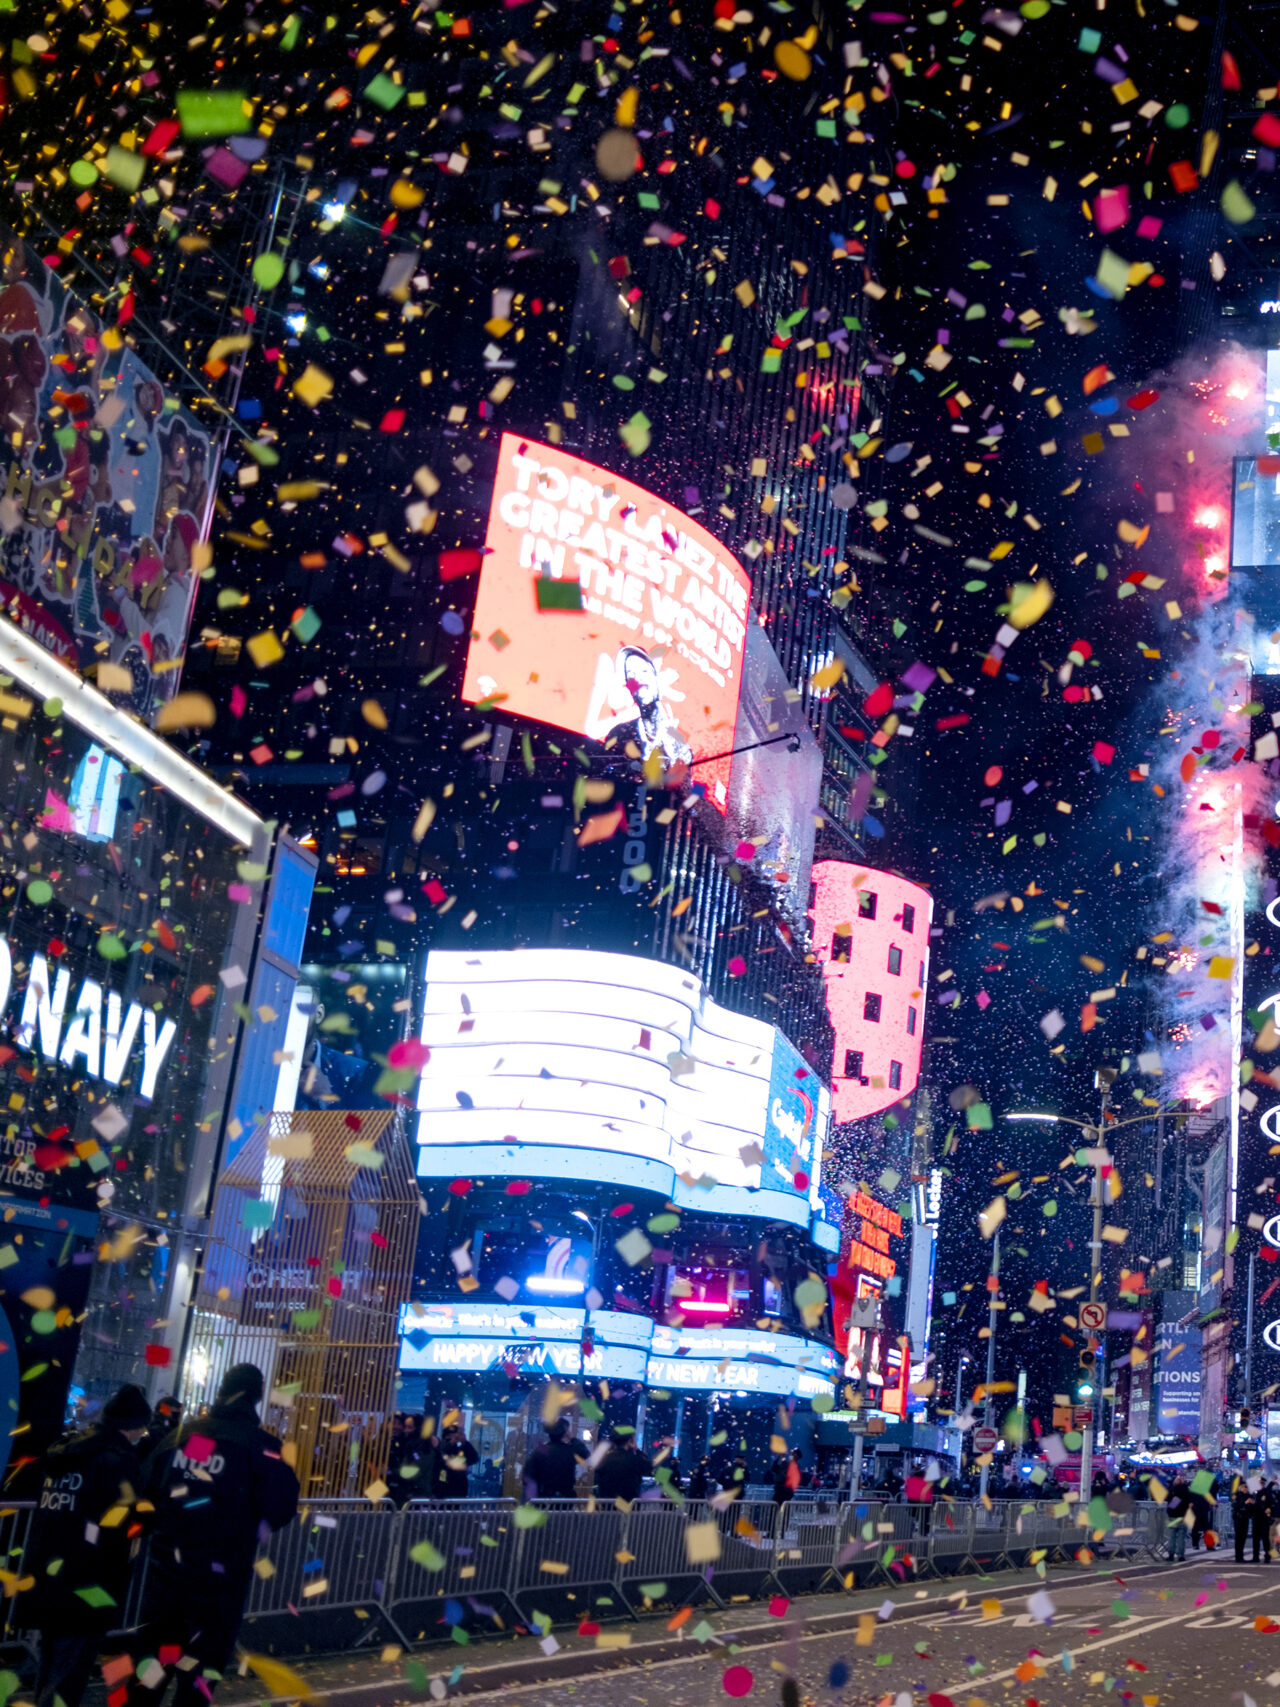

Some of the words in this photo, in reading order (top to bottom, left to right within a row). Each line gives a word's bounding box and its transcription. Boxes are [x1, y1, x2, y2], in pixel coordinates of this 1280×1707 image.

[512, 454, 620, 521] TORY
[623, 501, 714, 584] LANEZ
[716, 561, 747, 620] THE
[500, 491, 682, 593] GREATEST
[683, 577, 745, 652] ARTIST
[519, 532, 566, 579] IN
[573, 552, 646, 612] THE
[17, 952, 177, 1100] NAVY
[433, 1342, 494, 1364] HAPPY
[553, 1346, 603, 1371] YEAR
[665, 1362, 710, 1384] NEW
[712, 1365, 759, 1386] YEAR
[43, 1473, 83, 1491] NPD
[171, 1449, 225, 1475] NPD
